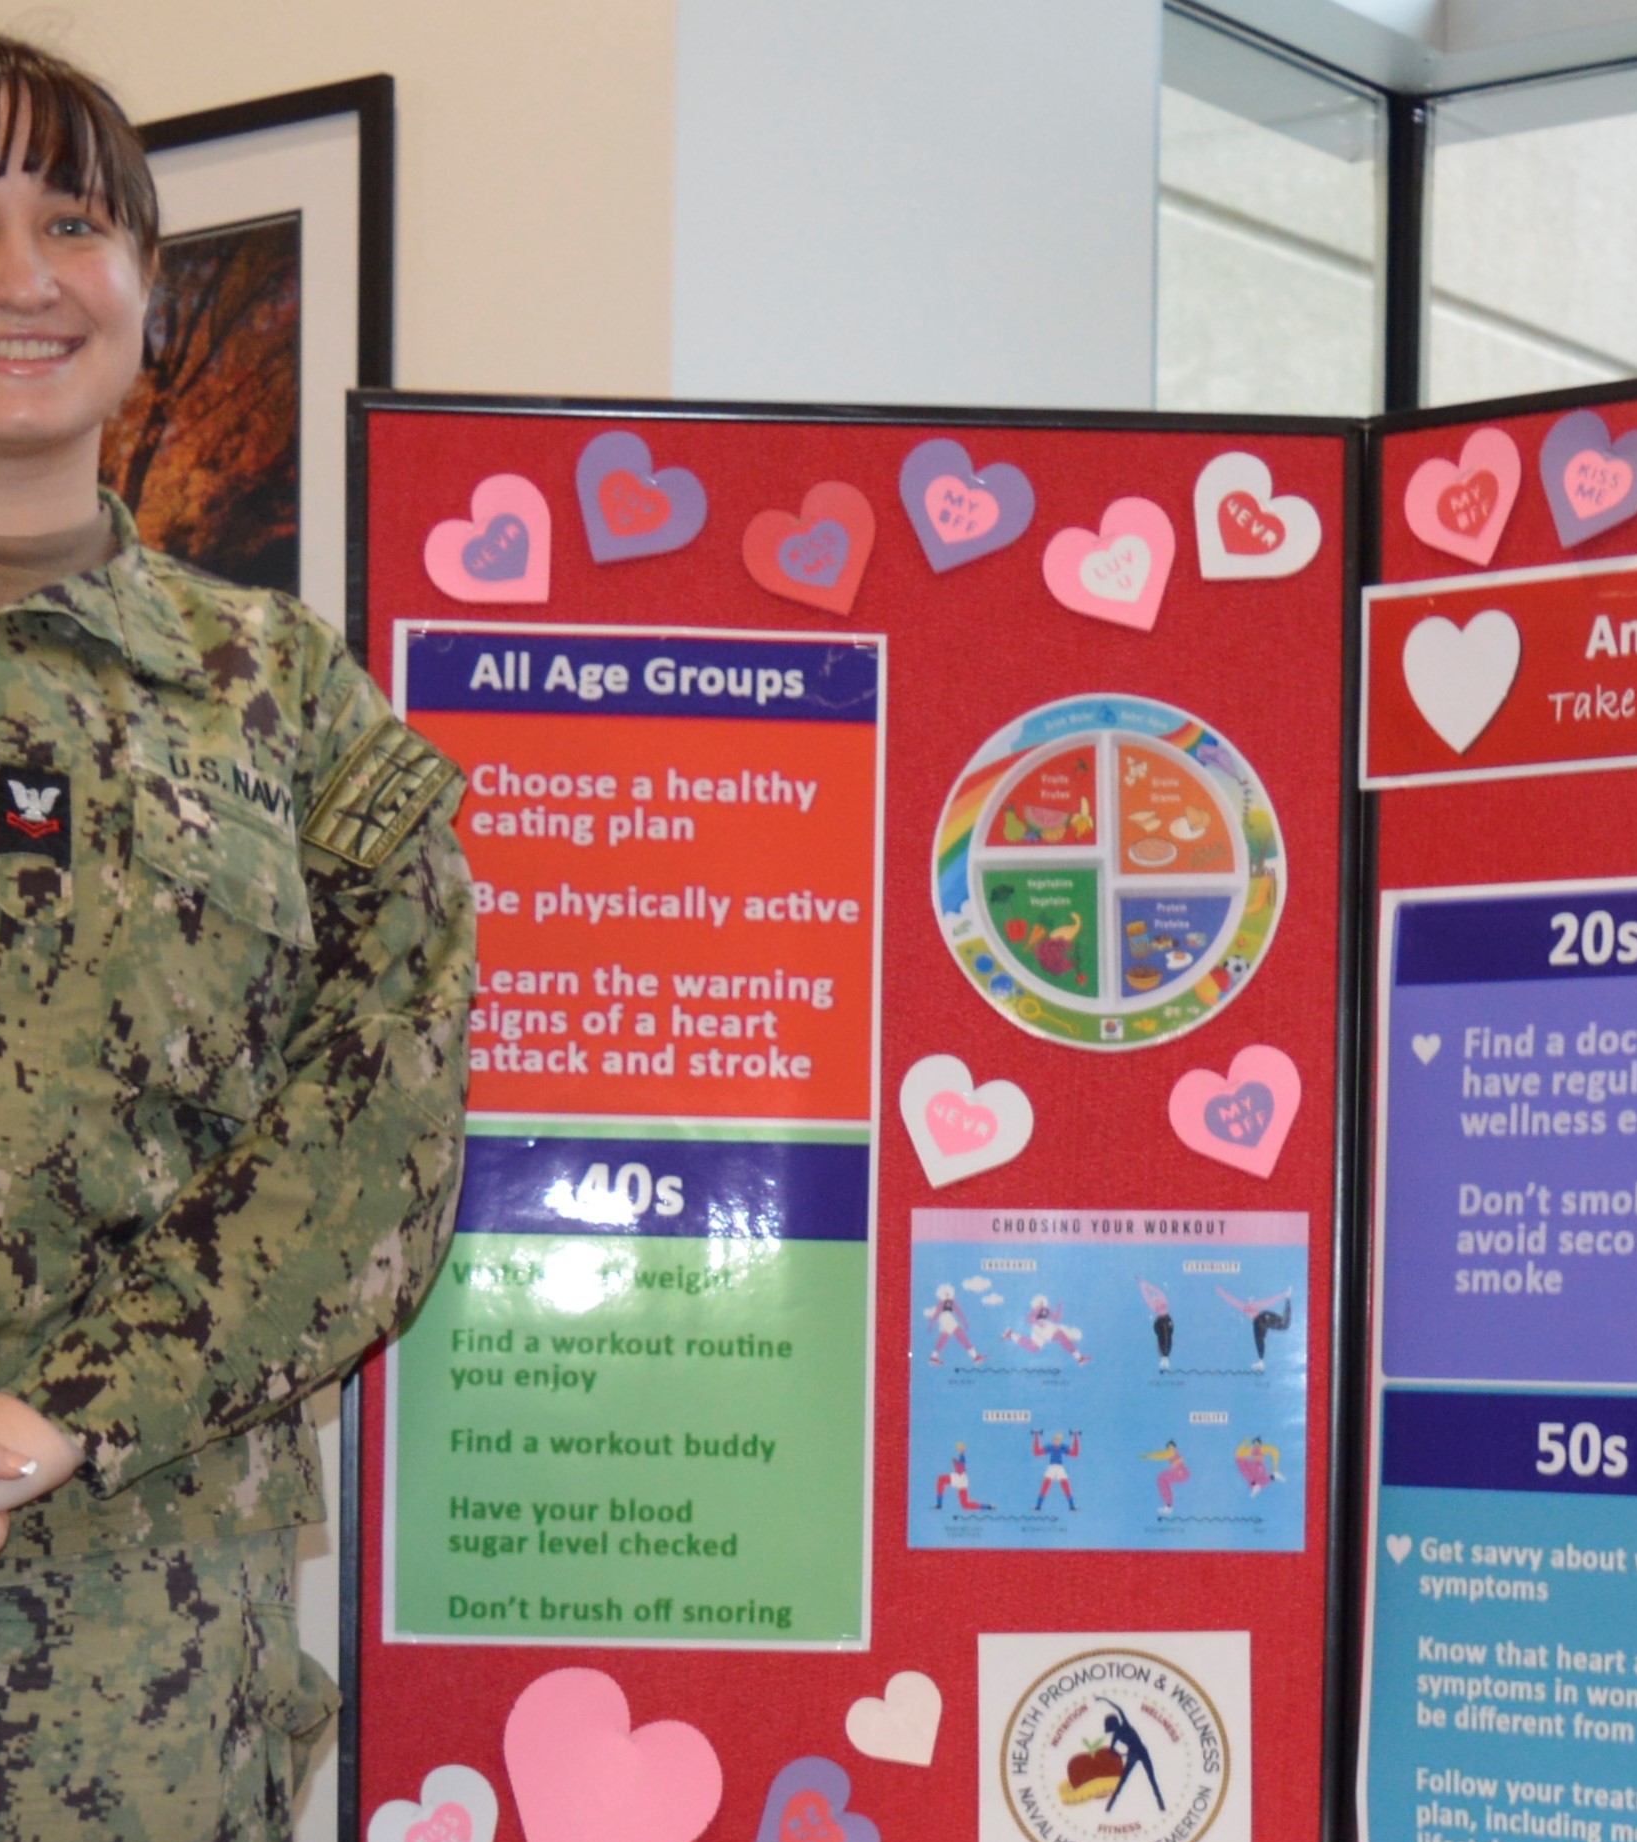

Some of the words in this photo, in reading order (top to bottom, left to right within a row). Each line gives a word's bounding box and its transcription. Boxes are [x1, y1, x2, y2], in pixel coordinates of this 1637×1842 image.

[470, 652, 529, 690] All
[545, 655, 629, 700] Age
[644, 658, 804, 704] Groups
[1548, 685, 1635, 721] Take
[169, 755, 227, 789] U.S.
[473, 765, 616, 798] Choose
[632, 774, 653, 801] a
[668, 769, 817, 811] healthy
[472, 806, 593, 845] eating
[610, 807, 694, 845] plan
[468, 883, 518, 912] Be
[535, 884, 730, 926] physically
[745, 891, 858, 922] active
[594, 965, 658, 996] the
[674, 970, 832, 1008] warning
[469, 1003, 567, 1041] signs
[583, 1004, 622, 1034] of
[635, 1011, 657, 1037] a
[673, 1005, 776, 1038] heart
[1465, 1025, 1534, 1058] Find
[1546, 1032, 1564, 1056] a
[470, 1043, 587, 1072] attack
[603, 1044, 674, 1074] and
[690, 1047, 810, 1077] stroke
[1463, 1066, 1540, 1096] have
[1462, 1104, 1606, 1135] wellness
[992, 1218, 1080, 1233] CHOOSING
[1092, 1219, 1133, 1233] YOUR
[1145, 1220, 1224, 1234] WORKOUT
[451, 1329, 512, 1352] Find
[524, 1334, 540, 1355] a
[552, 1332, 673, 1356] workout
[687, 1334, 792, 1358] routine
[450, 1368, 502, 1390] you
[515, 1364, 596, 1393] enjoy
[1537, 1423, 1627, 1477] 50s
[1421, 1538, 1463, 1563] Get
[1472, 1546, 1542, 1572] savvy
[1551, 1544, 1626, 1571] about
[1420, 1576, 1548, 1601] symptoms
[1012, 1708, 1041, 1774] HEALTH
[1039, 1663, 1150, 1707] PROMOTION
[1154, 1675, 1166, 1691] &
[1171, 1685, 1220, 1773] WELLNESS
[1051, 1704, 1088, 1747] NUTRITION
[1140, 1703, 1180, 1744] WELLNESS
[1020, 1787, 1052, 1839] NAVAL
[1098, 1823, 1141, 1834] FITNESS
